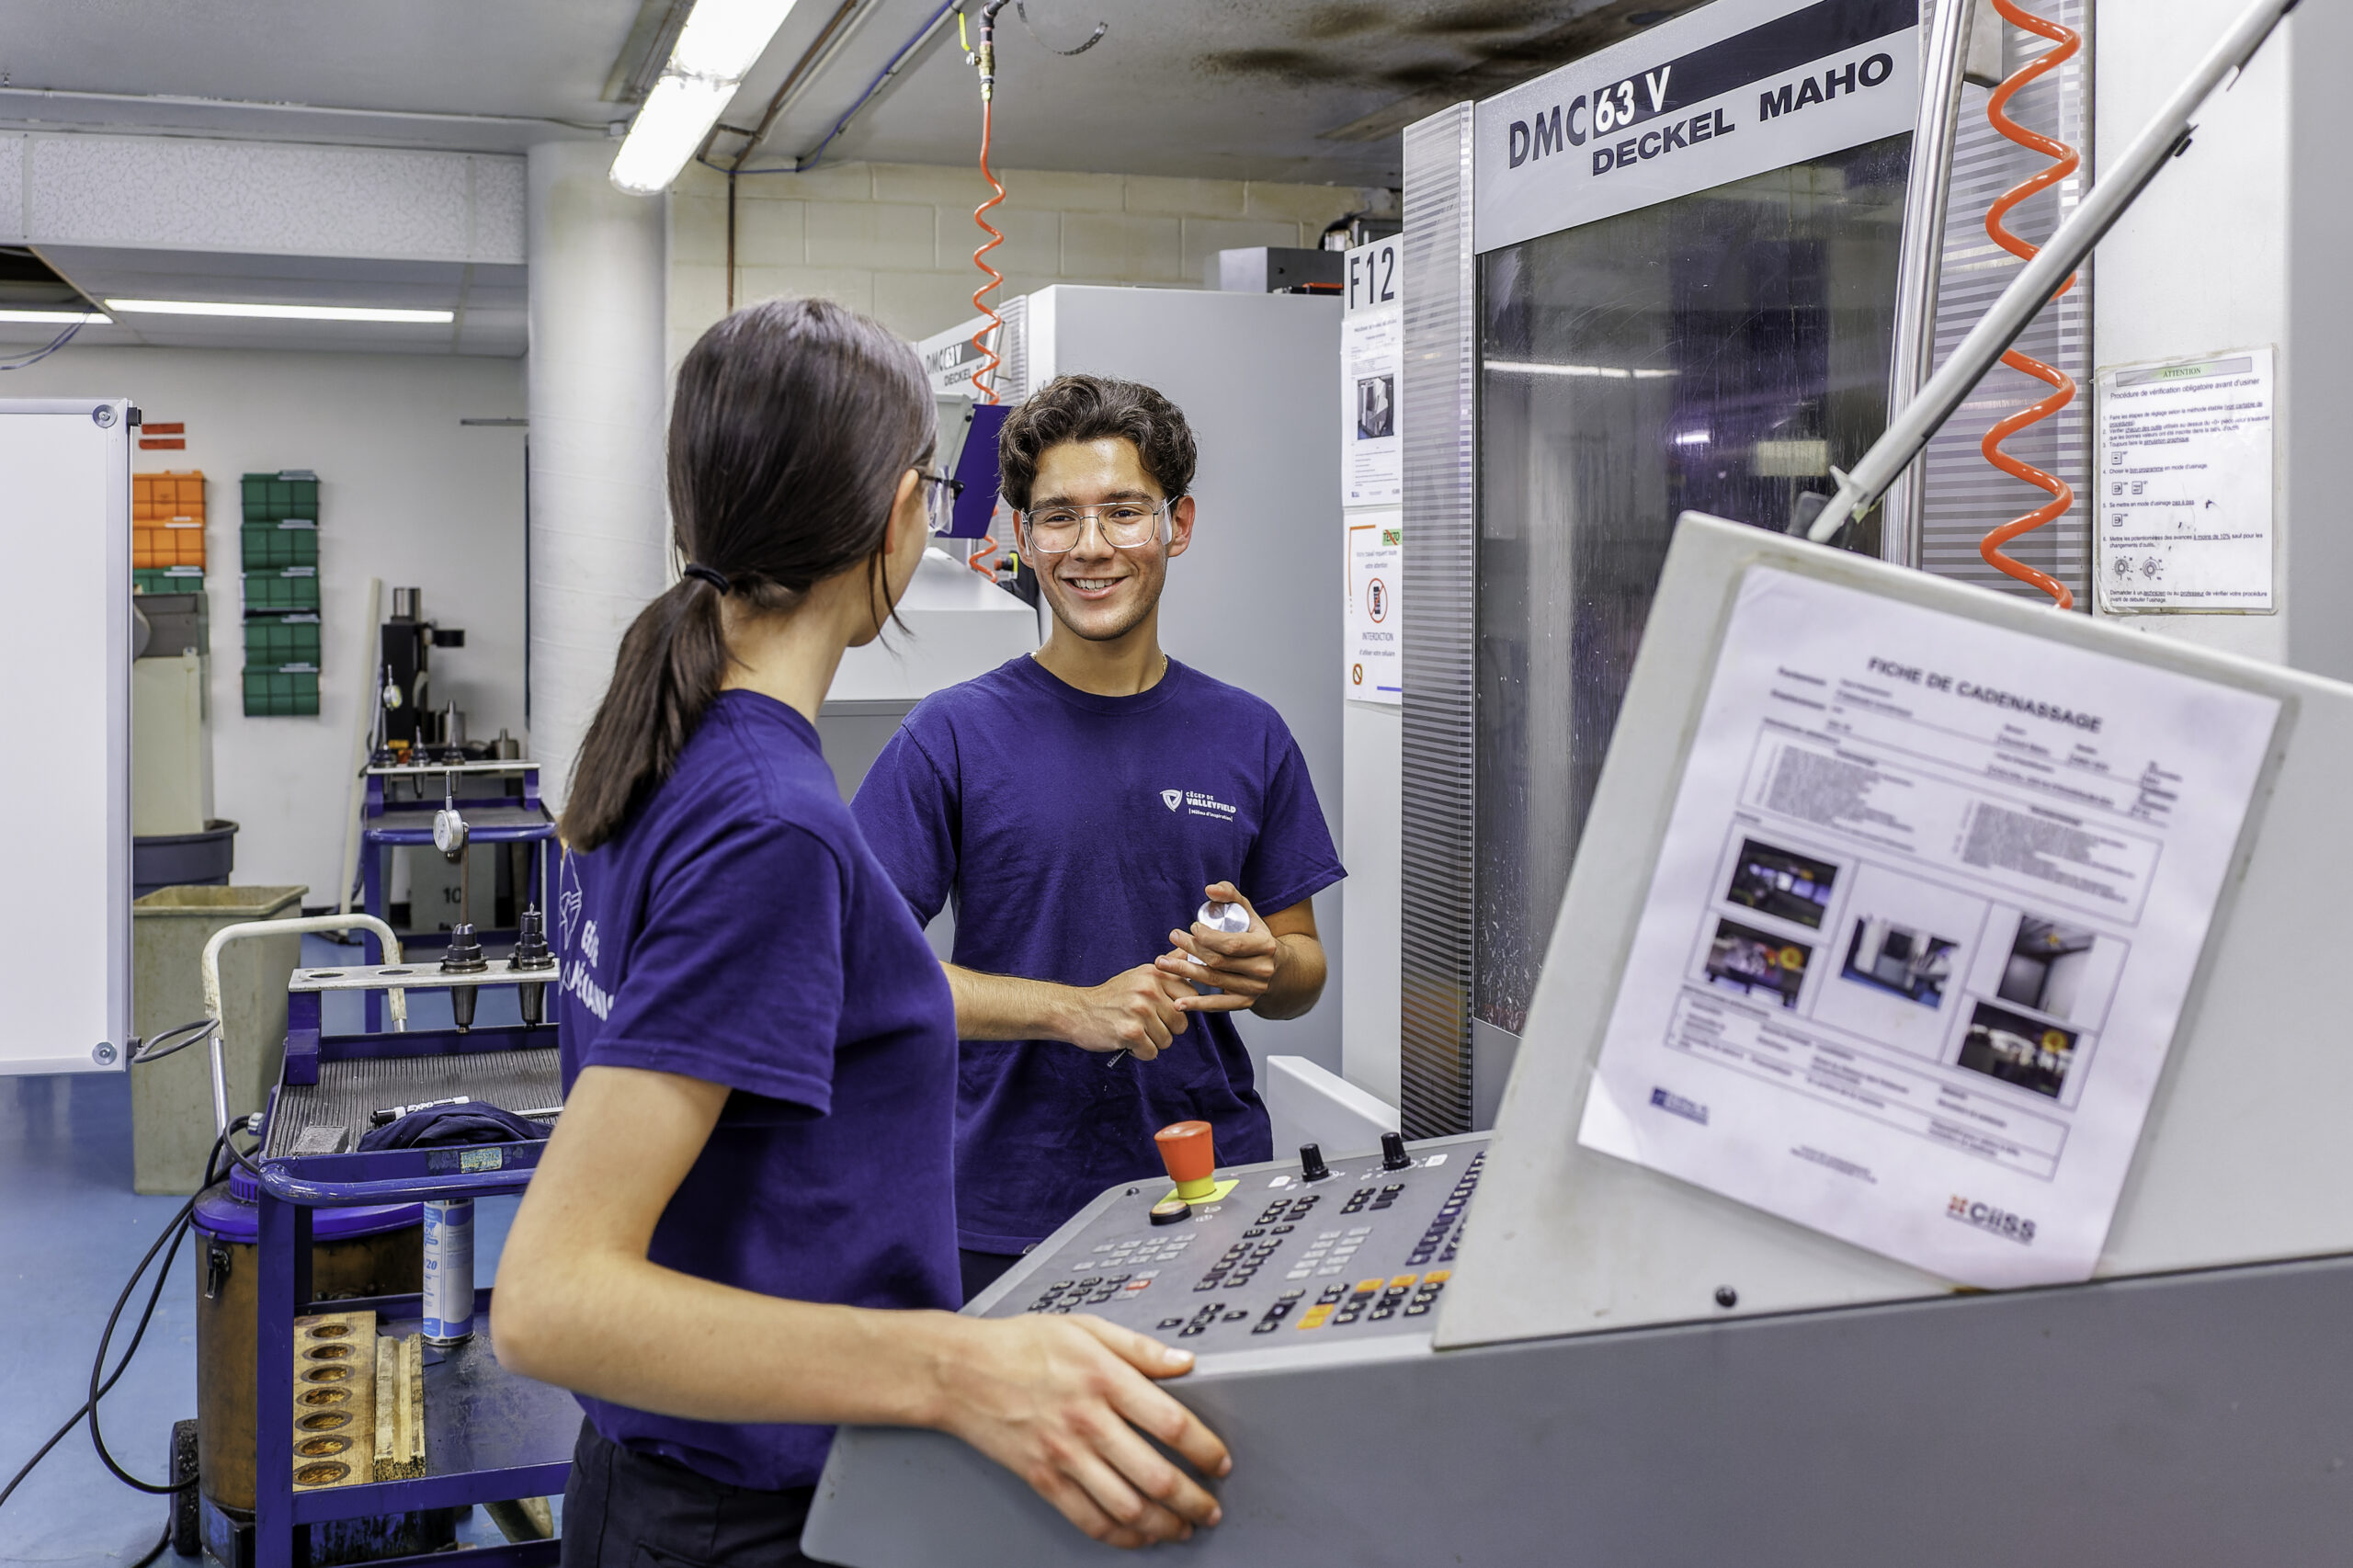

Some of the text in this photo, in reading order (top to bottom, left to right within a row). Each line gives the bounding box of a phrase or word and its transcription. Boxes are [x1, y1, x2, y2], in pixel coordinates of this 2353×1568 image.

[1509, 65, 1672, 169] DMC 63 V
[1592, 52, 1893, 176] DECKEL MAHO
[1350, 246, 1393, 310] F12
[944, 368, 972, 386] DECKEL
[2163, 368, 2201, 378] ATTENTION
[2110, 391, 2139, 400] Procédure
[2150, 386, 2181, 395] vérification
[2182, 383, 2213, 392] obligatoire
[2215, 381, 2233, 389] avant
[2234, 378, 2259, 387] d'usiner
[1362, 632, 1394, 642] INTERDICTION
[1868, 656, 2103, 734] FICHE DE CADENASSAGE
[1186, 797, 1236, 813] VALLEYFIELD
